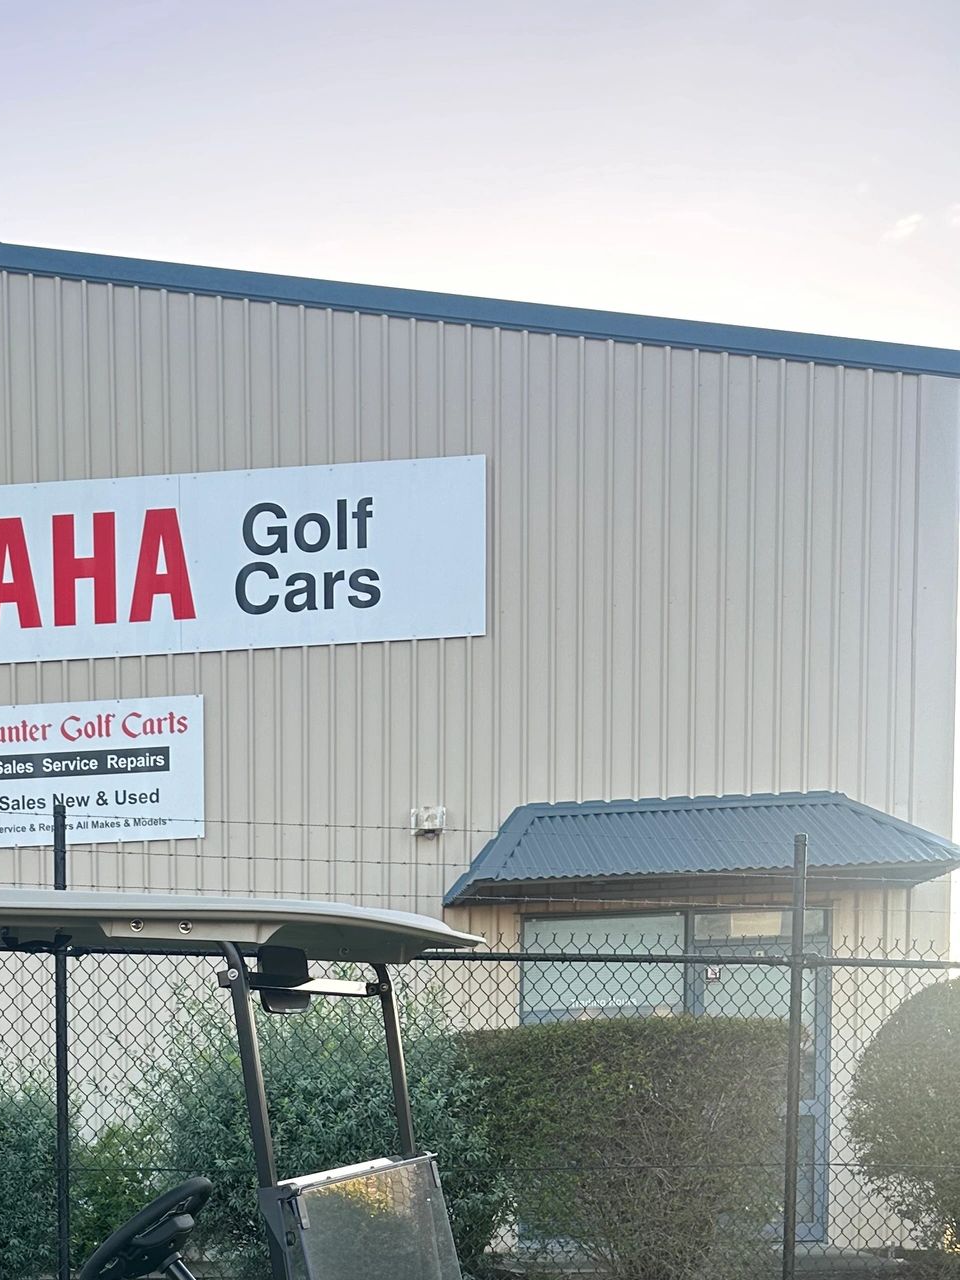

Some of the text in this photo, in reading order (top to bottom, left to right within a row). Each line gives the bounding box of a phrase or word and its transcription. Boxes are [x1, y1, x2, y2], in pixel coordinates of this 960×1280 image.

[241, 496, 376, 555] Golf
[235, 562, 382, 616] Cars
[60, 713, 116, 742] Golf
[121, 711, 188, 738] Carts
[42, 756, 99, 772] Service
[107, 752, 165, 771] Repairs
[53, 793, 90, 808] New
[96, 791, 109, 806] &
[115, 788, 160, 805] Used
[29, 823, 36, 832] &
[38, 822, 74, 832] Reprs
[76, 820, 89, 830] All
[91, 819, 121, 829] Makes
[123, 818, 131, 828] &
[133, 816, 167, 827] Models
